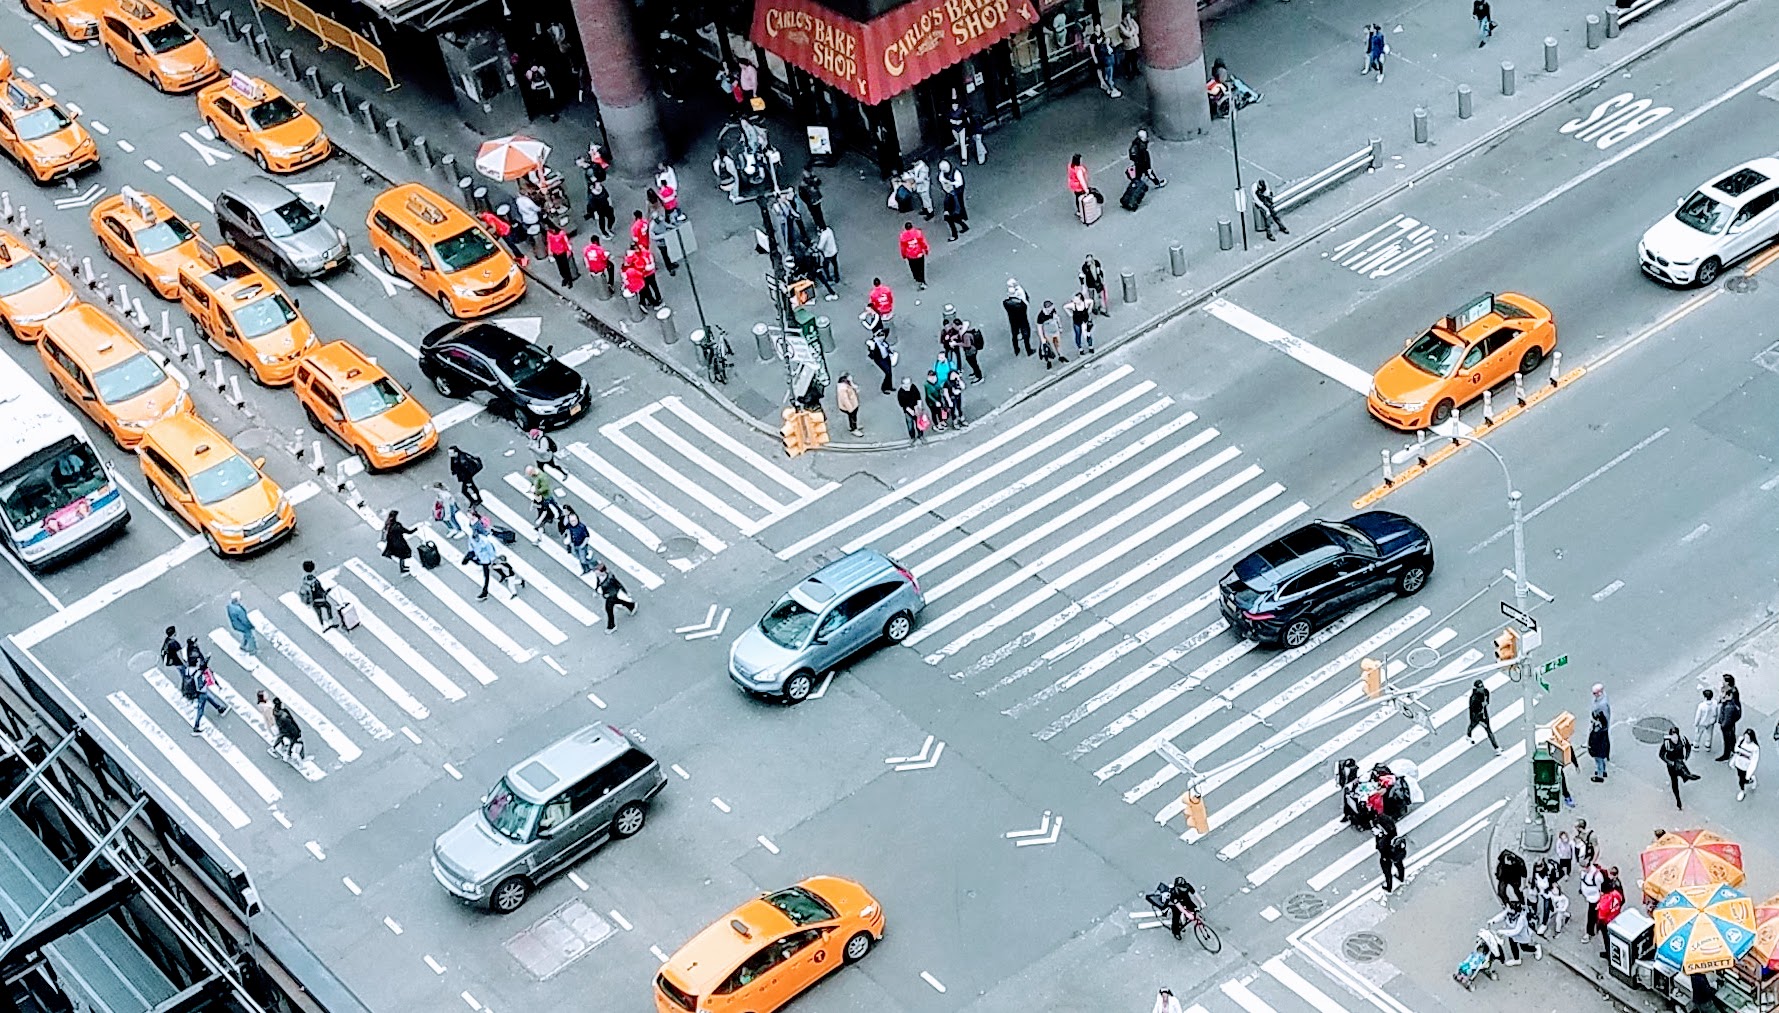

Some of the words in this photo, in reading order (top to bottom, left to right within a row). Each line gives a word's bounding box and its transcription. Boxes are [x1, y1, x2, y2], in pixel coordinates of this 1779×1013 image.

[766, 9, 812, 37] CARLO'S
[814, 18, 856, 60] BAKE
[884, 7, 943, 76] CARLO'S
[952, 0, 1009, 46] SHOP
[813, 41, 857, 81] SHOP
[1560, 92, 1674, 150] BUS
